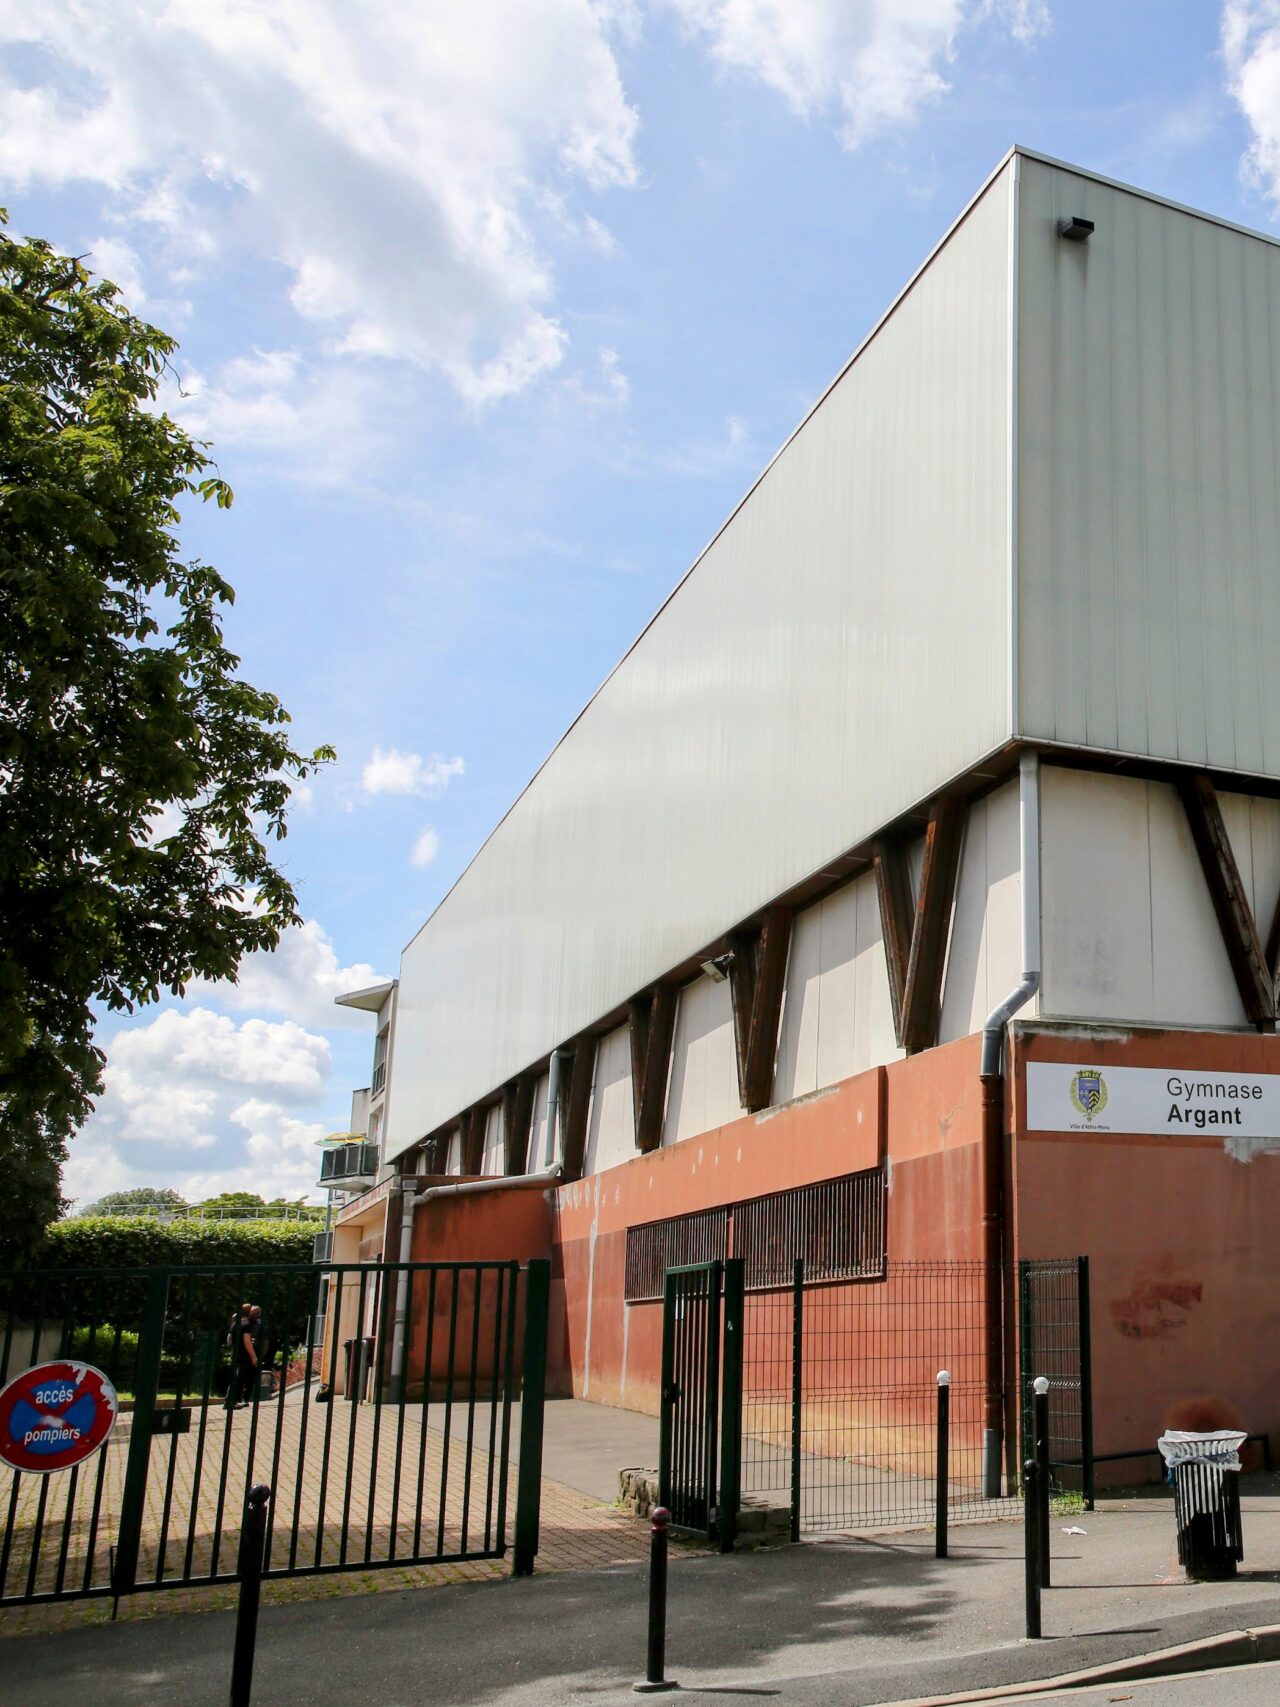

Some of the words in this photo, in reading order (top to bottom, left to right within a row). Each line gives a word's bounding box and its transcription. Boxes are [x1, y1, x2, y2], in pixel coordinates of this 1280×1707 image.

[1167, 1077, 1263, 1101] Gymnase
[1167, 1103, 1242, 1128] Argant
[35, 1385, 74, 1404] accès
[24, 1427, 81, 1445] pompiers
